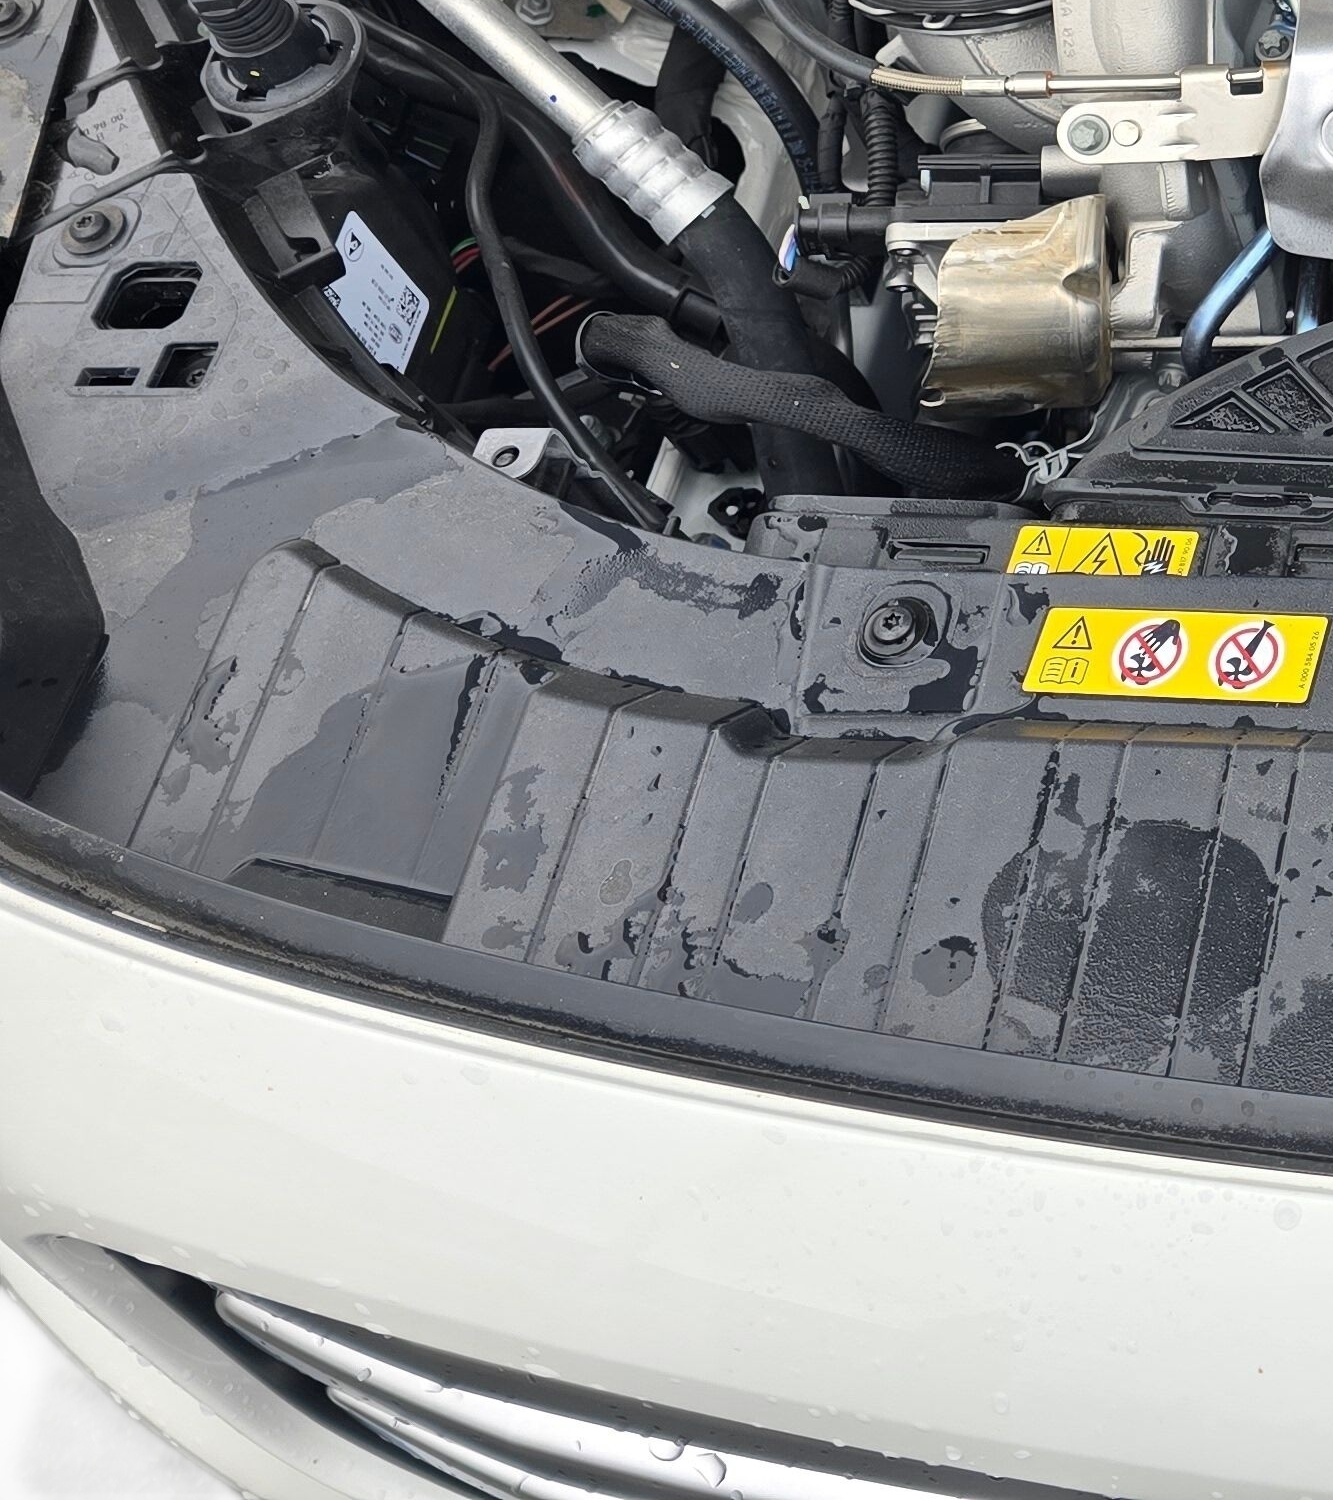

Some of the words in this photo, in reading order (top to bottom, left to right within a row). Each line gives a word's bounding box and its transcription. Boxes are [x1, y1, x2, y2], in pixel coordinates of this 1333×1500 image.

[1312, 630, 1320, 640] 26
[1308, 641, 1317, 651] 05
[1304, 652, 1314, 667] 584
[1300, 667, 1309, 682] 000
